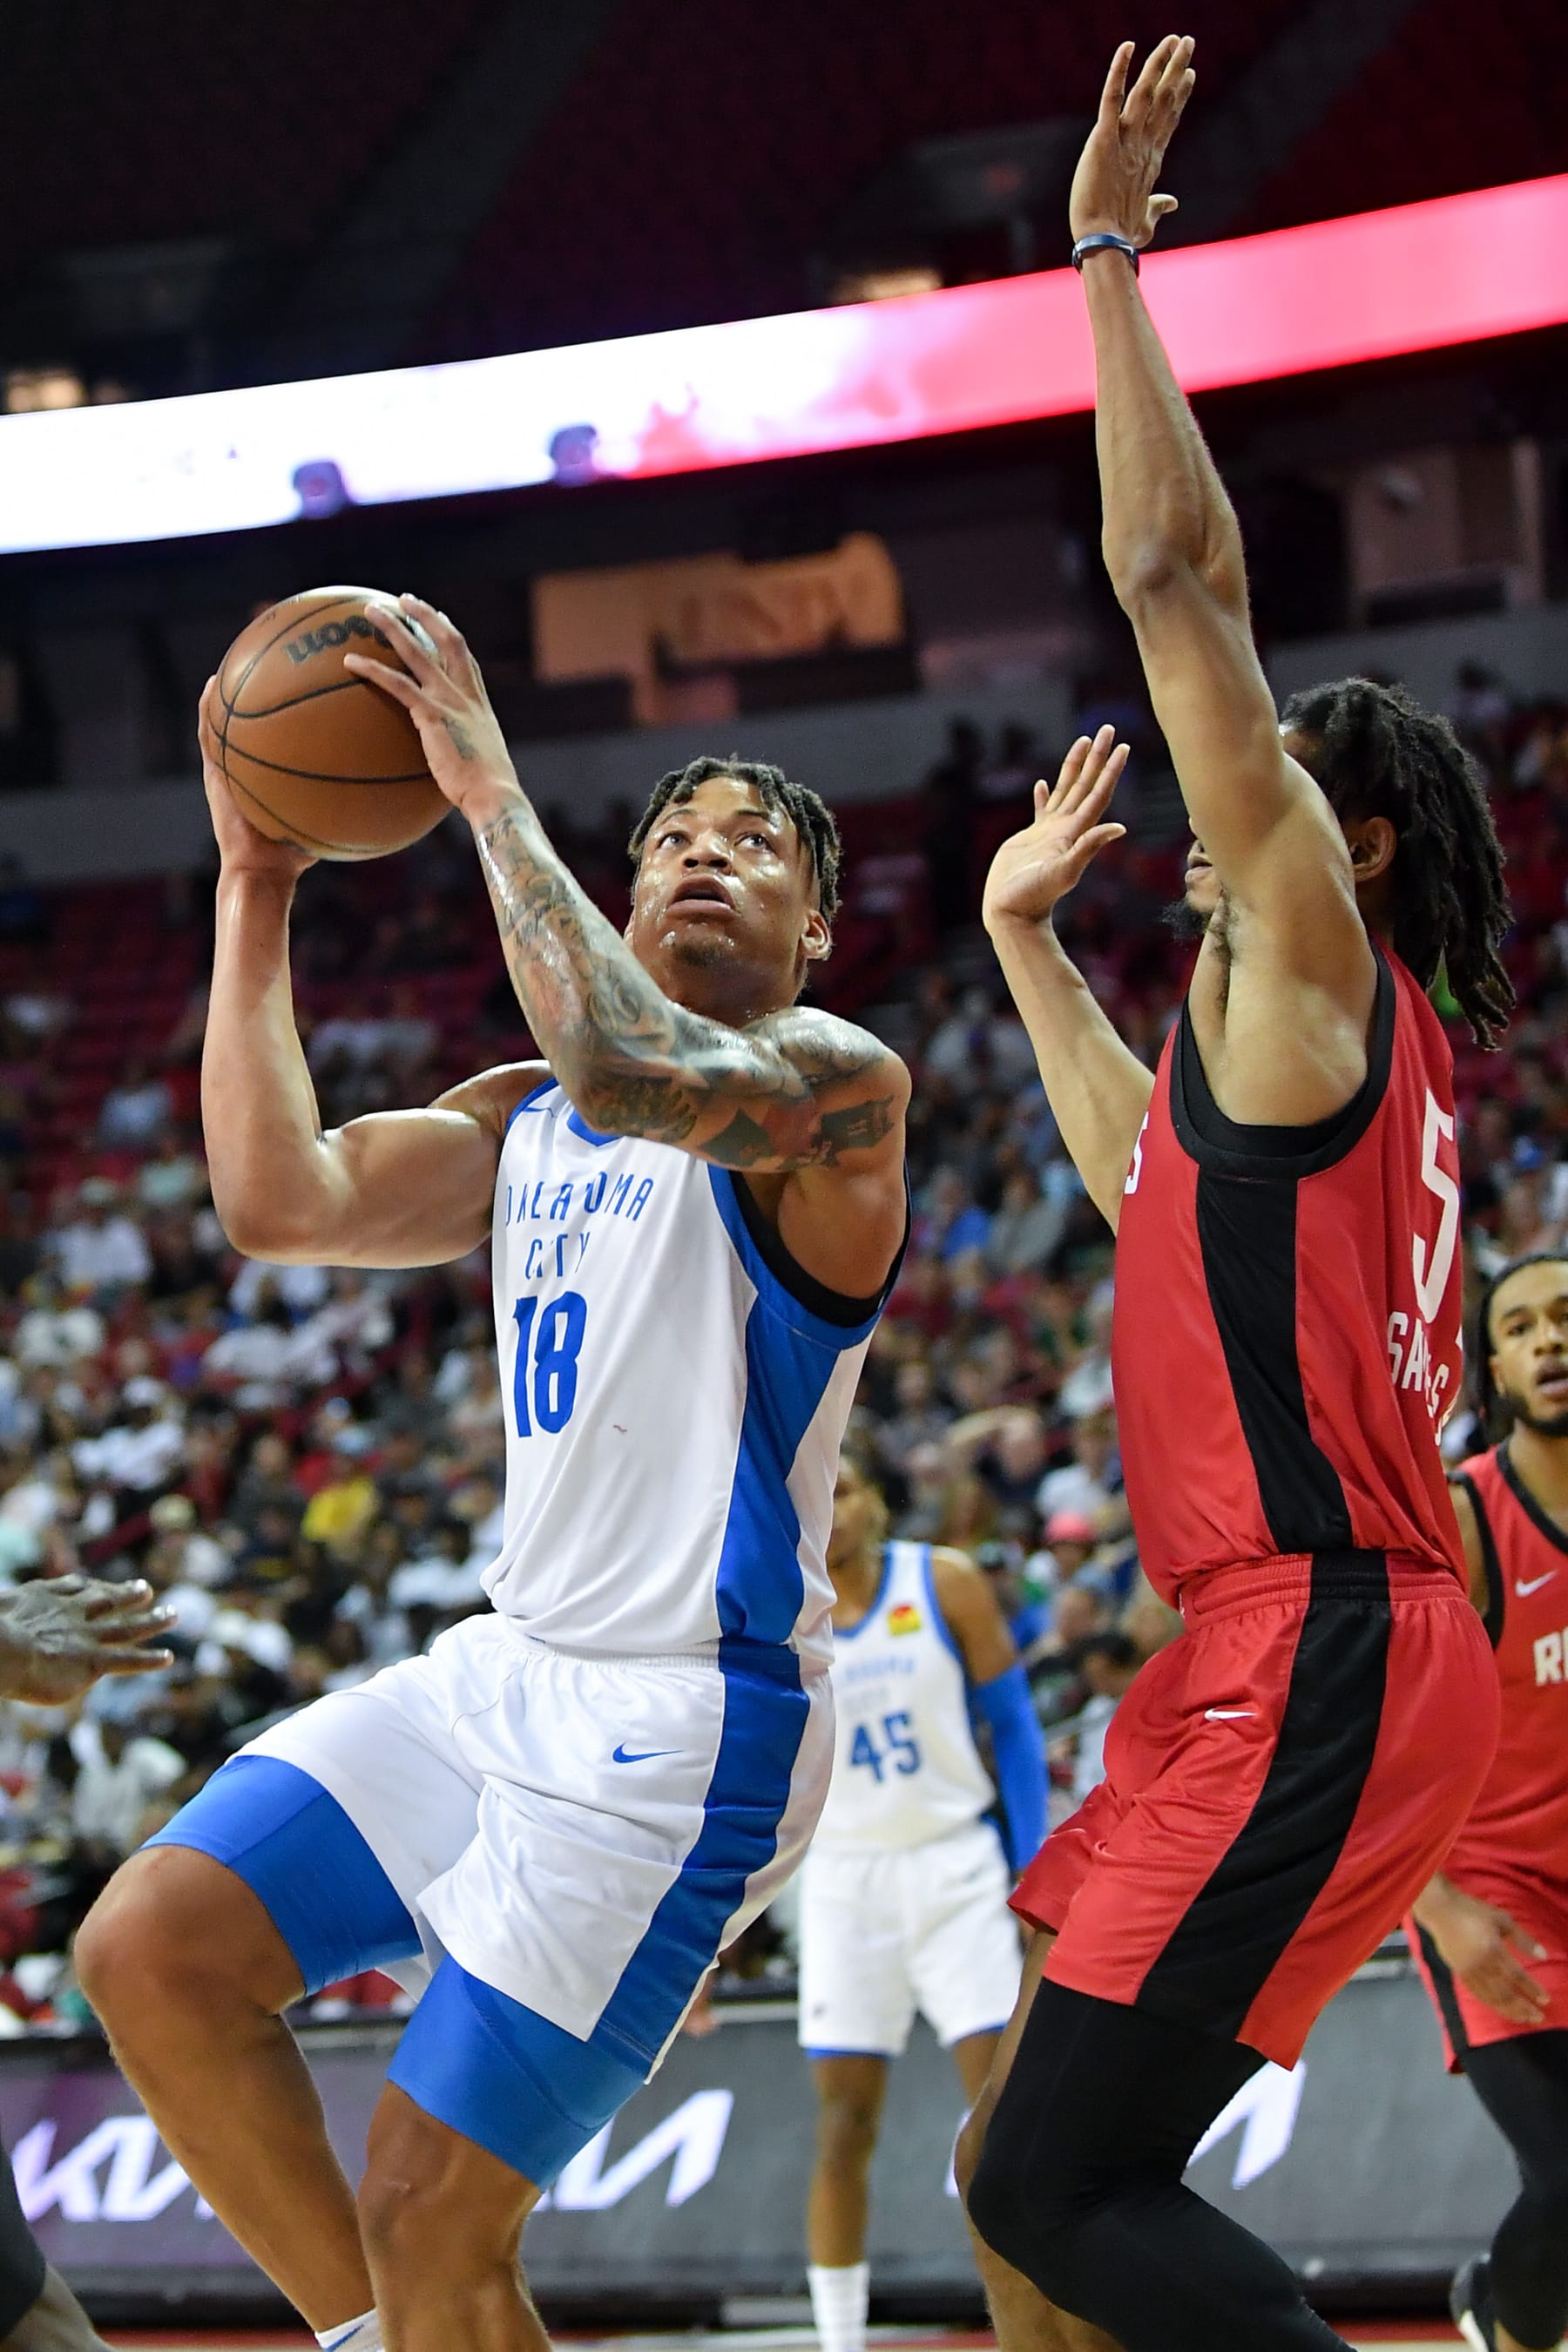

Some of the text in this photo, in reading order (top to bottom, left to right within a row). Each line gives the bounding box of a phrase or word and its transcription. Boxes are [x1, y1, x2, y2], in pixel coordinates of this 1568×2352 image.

[1412, 1087, 1463, 1351] 5
[512, 1291, 587, 1437] 18
[1533, 1625, 1568, 1687] R
[849, 1710, 921, 1783] 45
